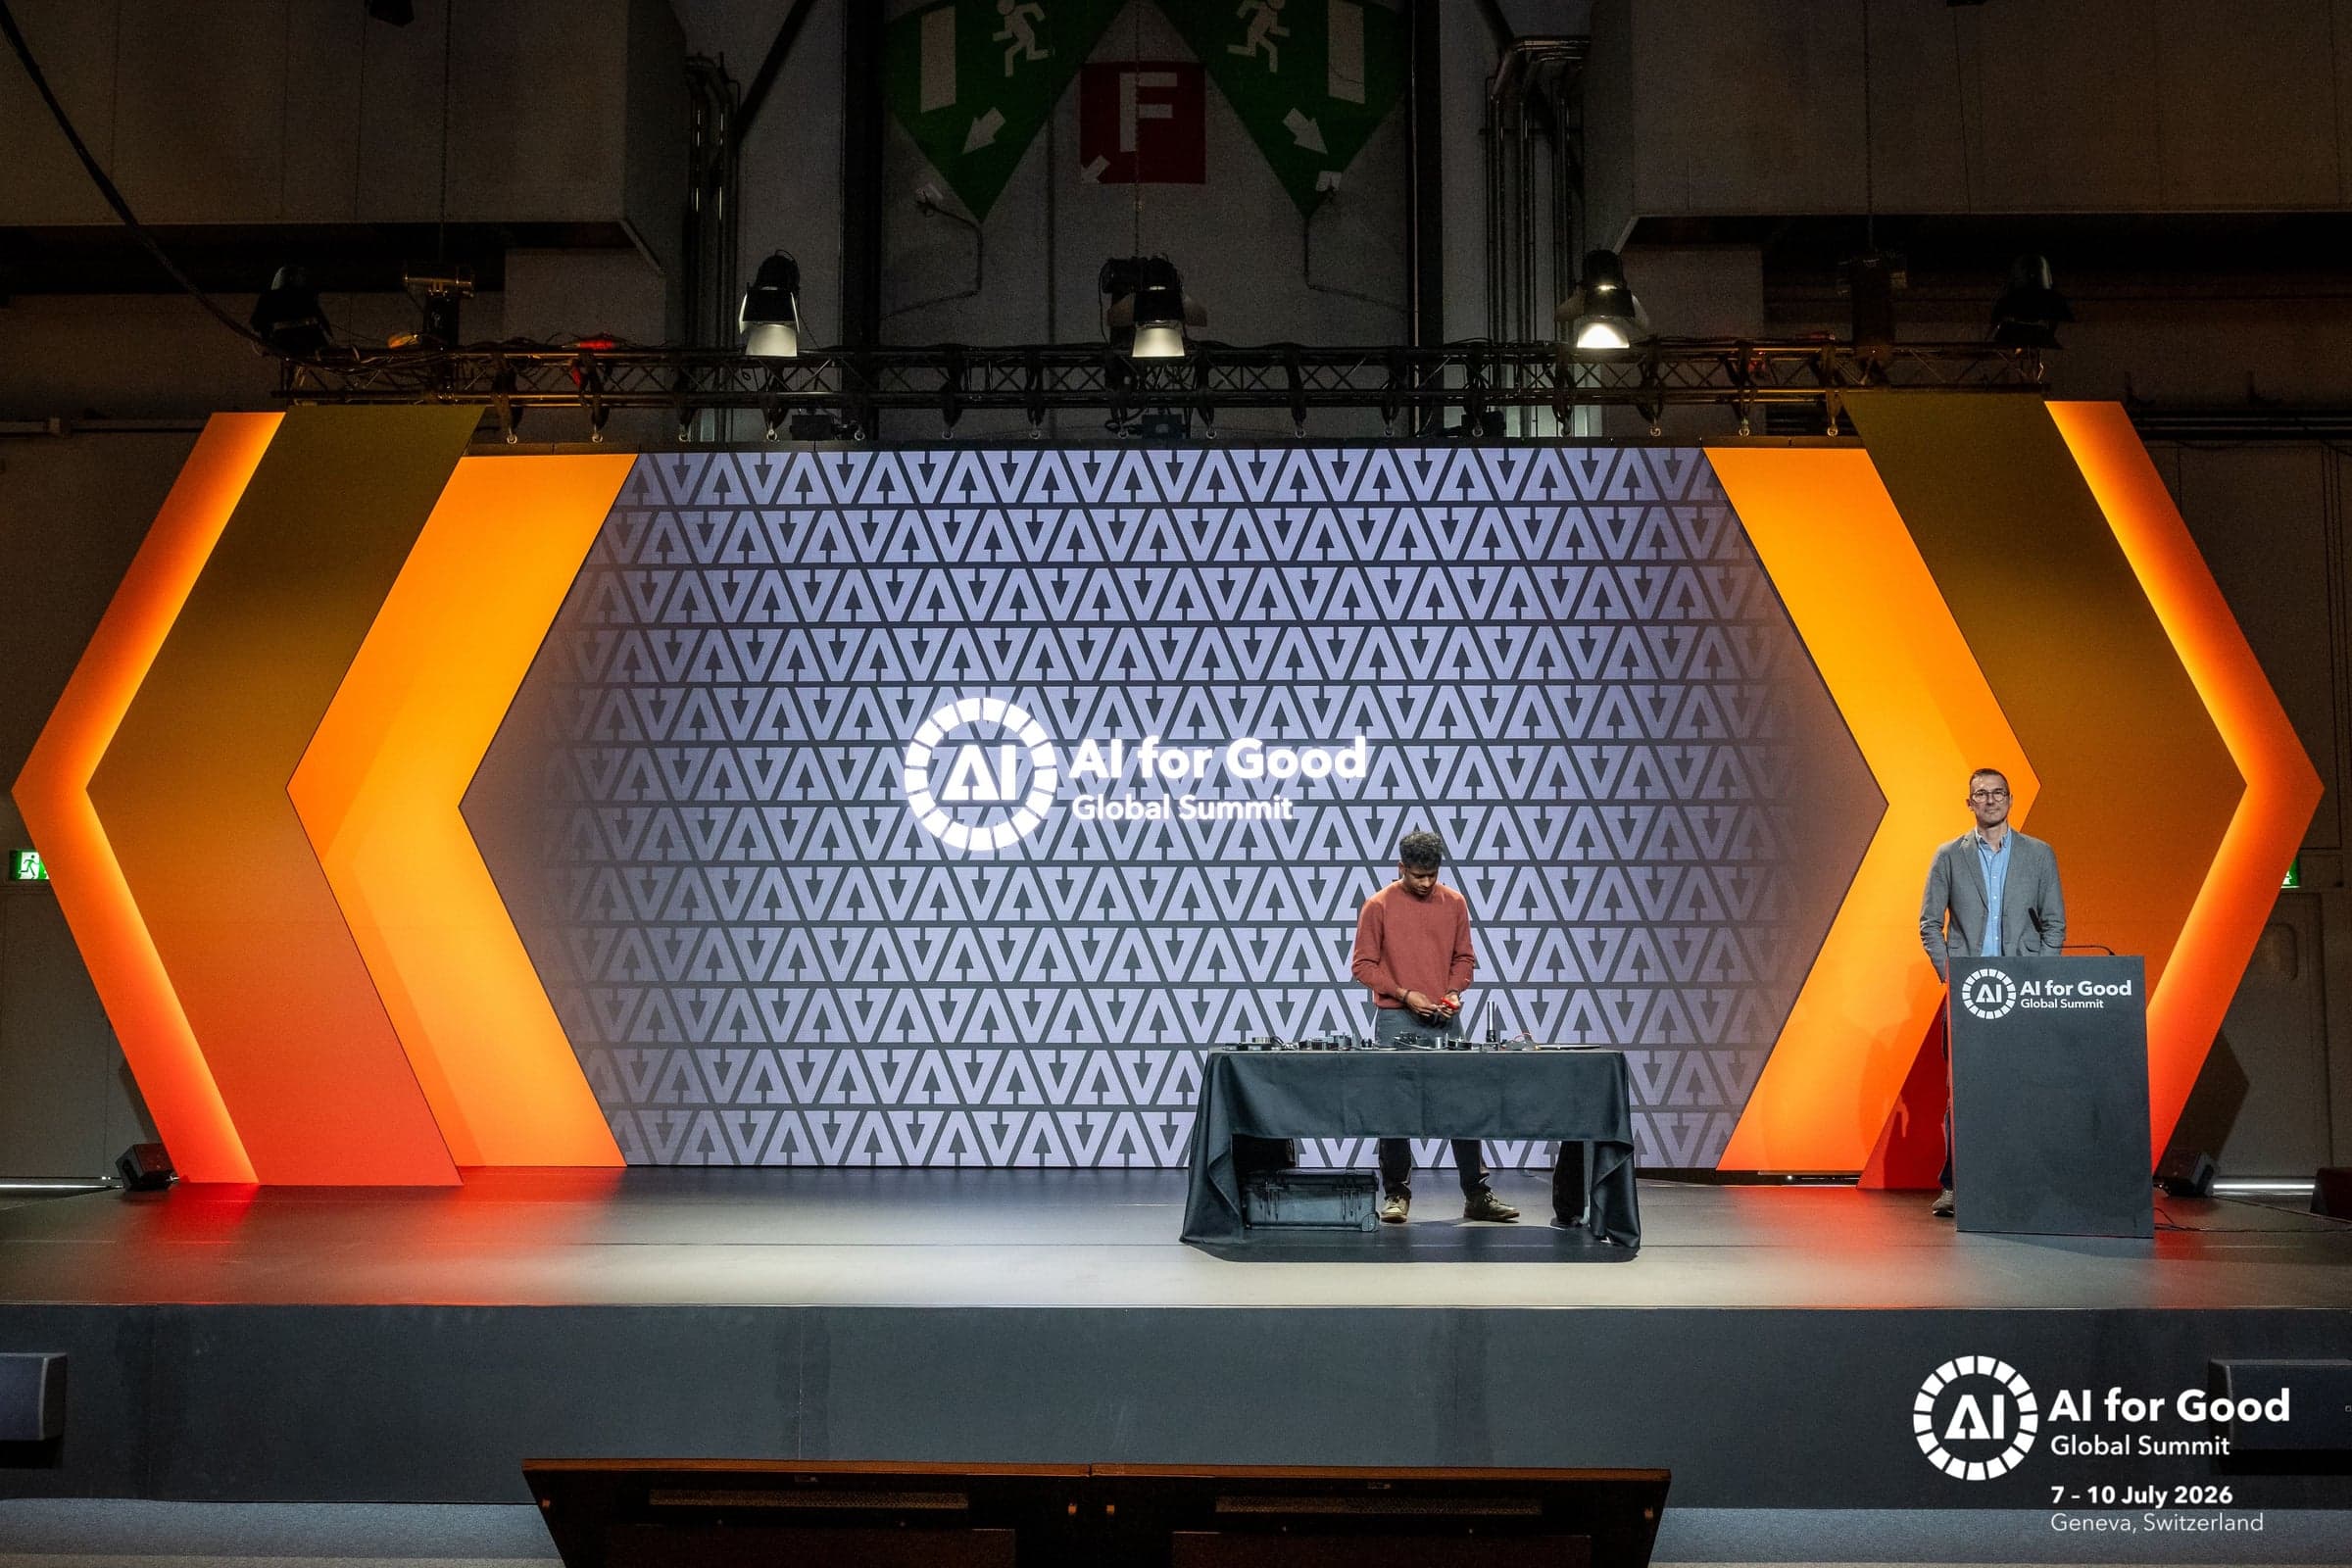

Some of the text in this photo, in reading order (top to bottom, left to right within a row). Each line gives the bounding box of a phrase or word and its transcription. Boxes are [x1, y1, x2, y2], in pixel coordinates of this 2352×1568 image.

[1119, 72, 1178, 152] F
[1069, 735, 1366, 778] AI for Good
[943, 745, 1016, 801] AI
[1072, 793, 1293, 820] Global Summit
[1975, 983, 2002, 1004] AI
[2020, 980, 2132, 997] AI for Good
[2020, 998, 2104, 1009] Global Summit
